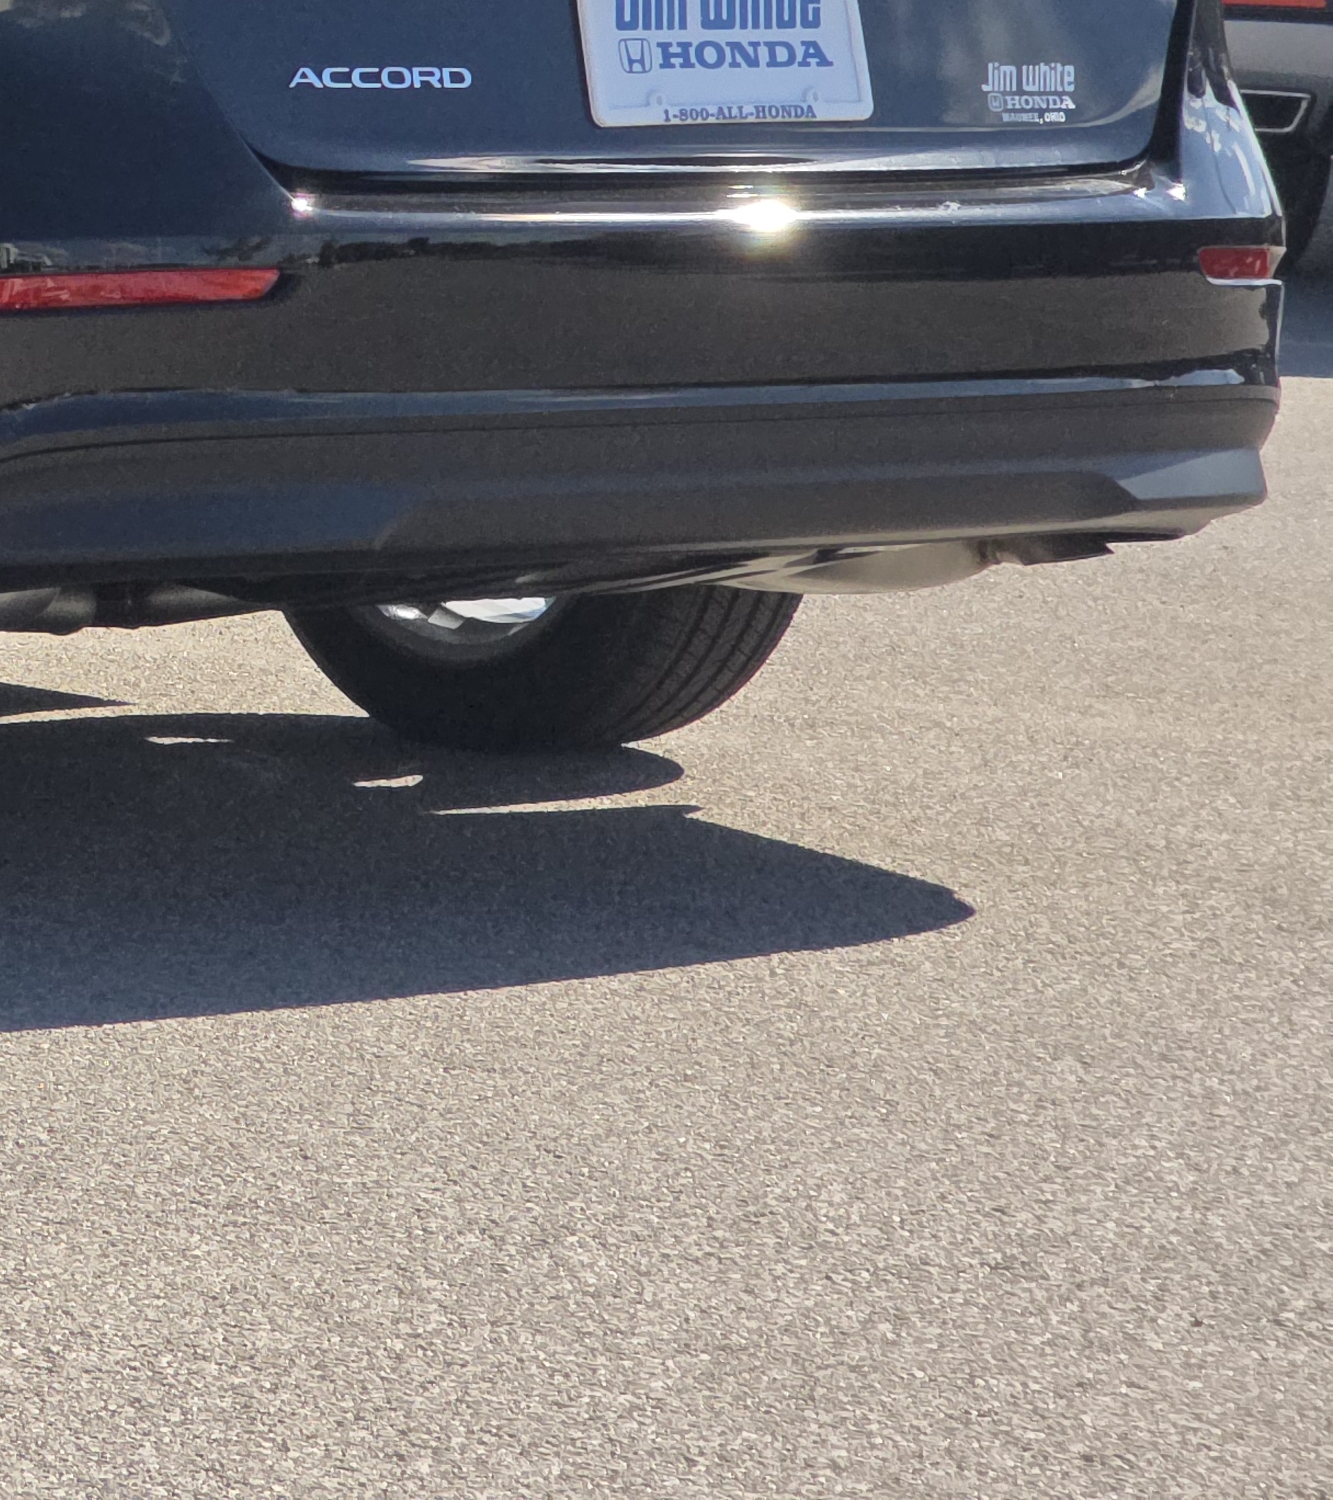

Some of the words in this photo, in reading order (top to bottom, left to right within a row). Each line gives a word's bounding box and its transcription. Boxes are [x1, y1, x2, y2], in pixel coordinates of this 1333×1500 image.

[656, 40, 834, 70] HONDA
[288, 66, 473, 89] ACCORD
[1004, 95, 1076, 110] HONDA
[663, 104, 818, 123] 1-800-ALL-HONDA
